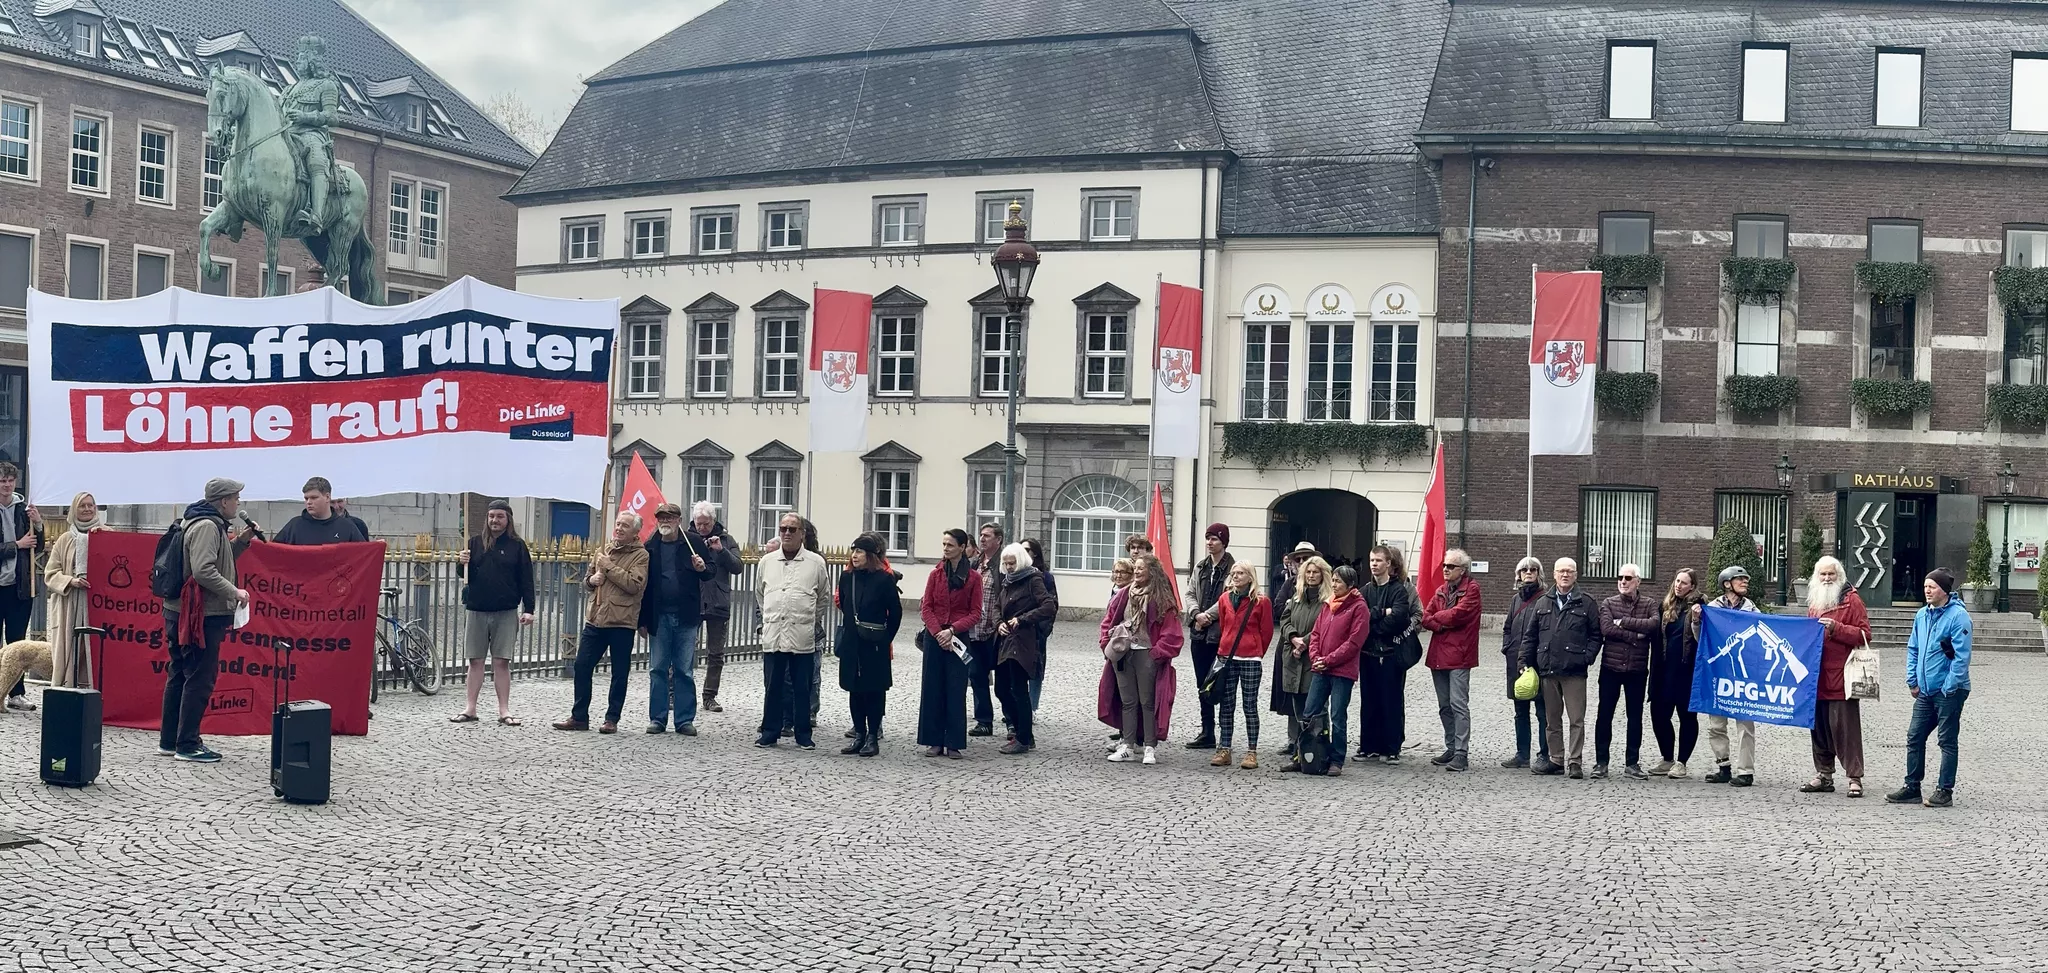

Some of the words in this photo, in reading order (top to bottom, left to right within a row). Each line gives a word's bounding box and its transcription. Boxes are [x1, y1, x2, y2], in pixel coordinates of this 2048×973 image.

[138, 325, 385, 382] Waffen
[403, 320, 604, 372] runter
[86, 391, 293, 444] Löhne
[312, 379, 459, 439] rauf!
[500, 407, 523, 422] Die
[526, 402, 566, 419] Linke
[531, 429, 571, 438] Düsseldorf
[1854, 473, 1934, 488] RATHAUS
[243, 573, 308, 602] Keller,
[92, 594, 161, 614] Oberlob
[254, 601, 366, 622] Rheinmetall
[211, 694, 247, 710] Linke
[1717, 677, 1798, 706] DFG-VK
[1717, 697, 1743, 707] Deutsche
